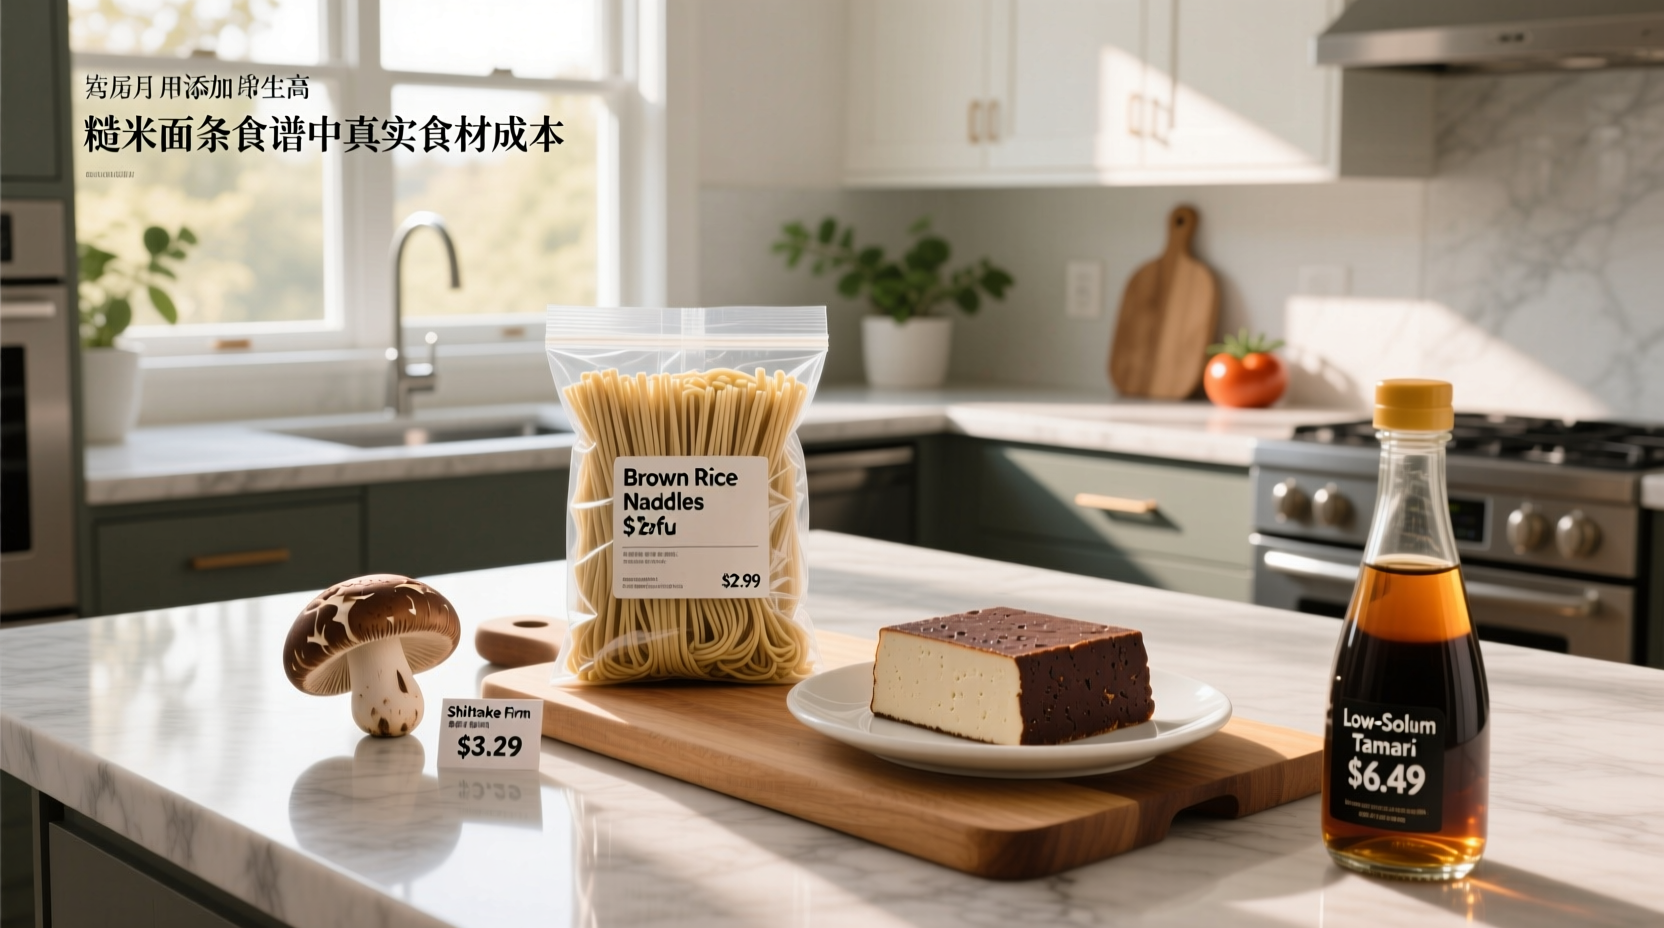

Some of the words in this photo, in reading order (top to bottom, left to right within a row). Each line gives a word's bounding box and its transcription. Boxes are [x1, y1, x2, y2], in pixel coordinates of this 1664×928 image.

[623, 467, 689, 487] Brown
[694, 467, 739, 487] Rice
[623, 491, 705, 511] Naddles
[721, 573, 761, 589] $2.99
[1343, 707, 1437, 736] Low-Solum
[457, 734, 523, 760] $3.29
[1351, 732, 1417, 758] Tamari
[1347, 755, 1426, 796] $6.49
